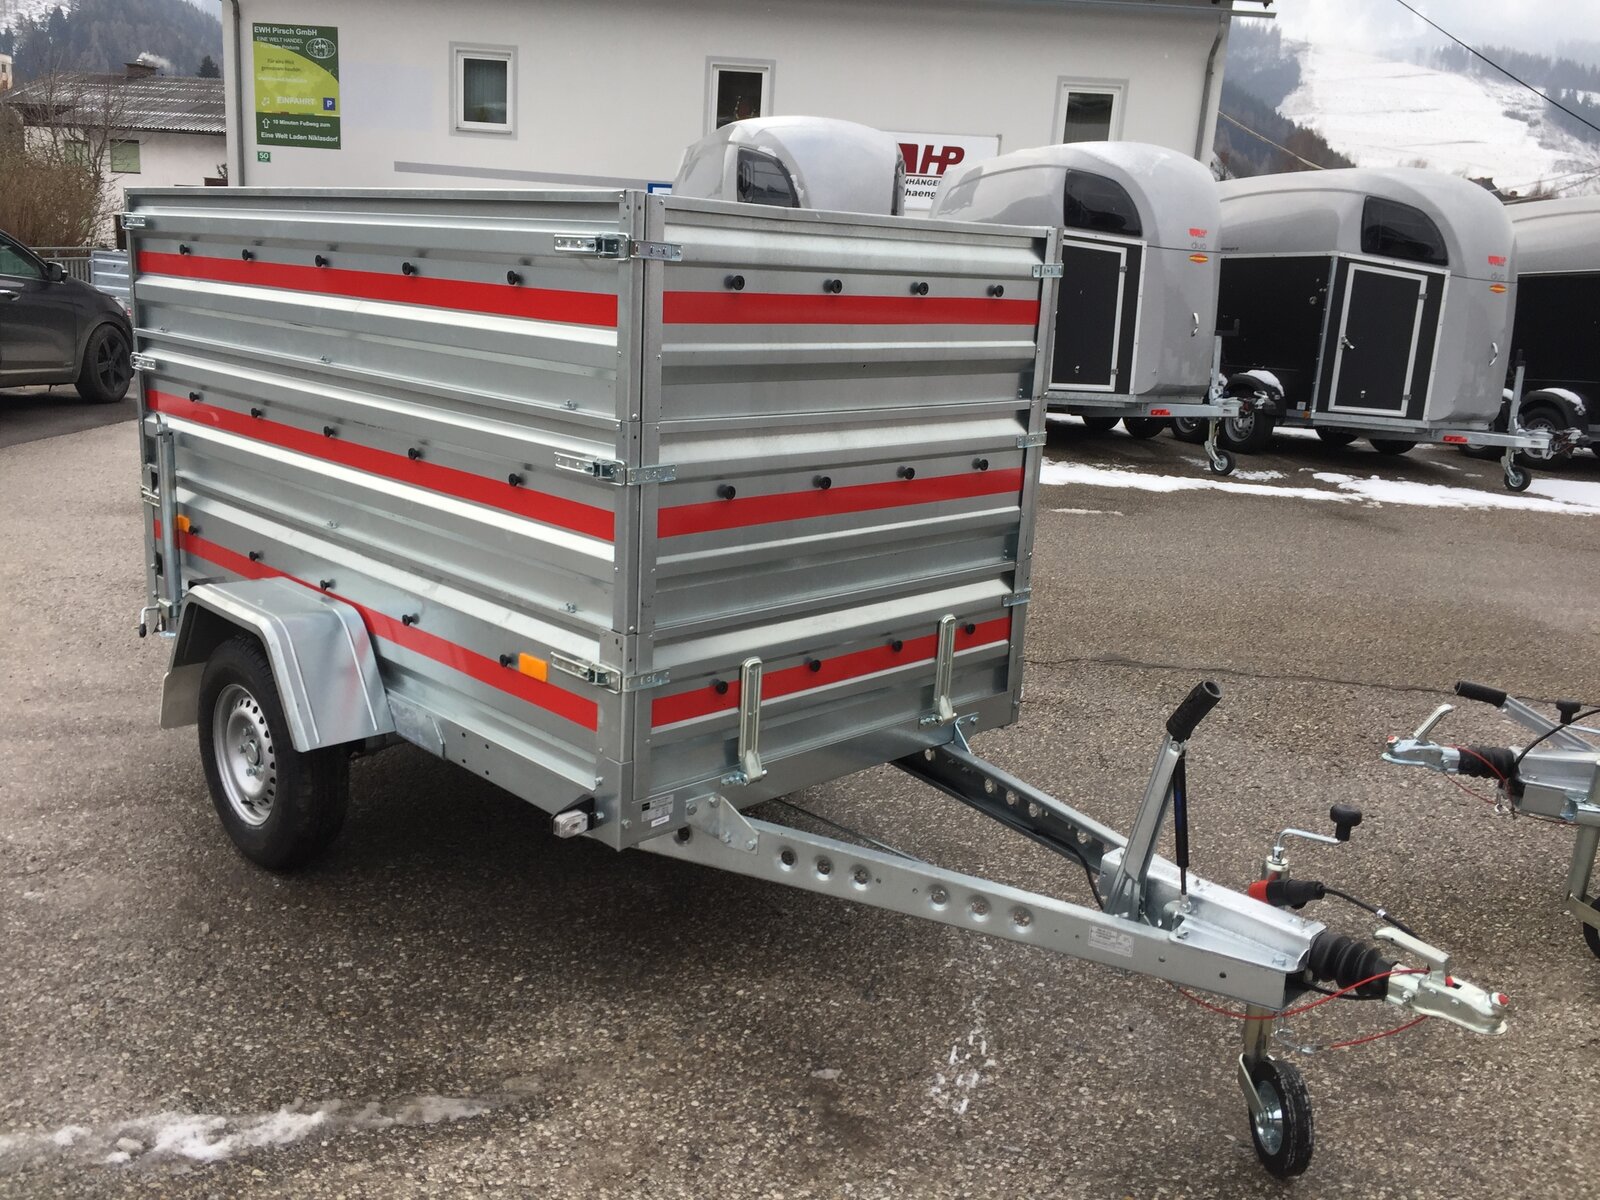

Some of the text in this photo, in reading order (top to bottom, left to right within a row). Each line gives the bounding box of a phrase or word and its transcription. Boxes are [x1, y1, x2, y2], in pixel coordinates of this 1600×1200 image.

[254, 26, 318, 36] EWH Pirsch GmbH
[277, 96, 316, 105] EINFAHRT
[299, 120, 319, 128] Fußweg
[260, 131, 274, 139] Eine
[289, 133, 307, 141] Laden
[308, 134, 338, 142] Niklasdorf
